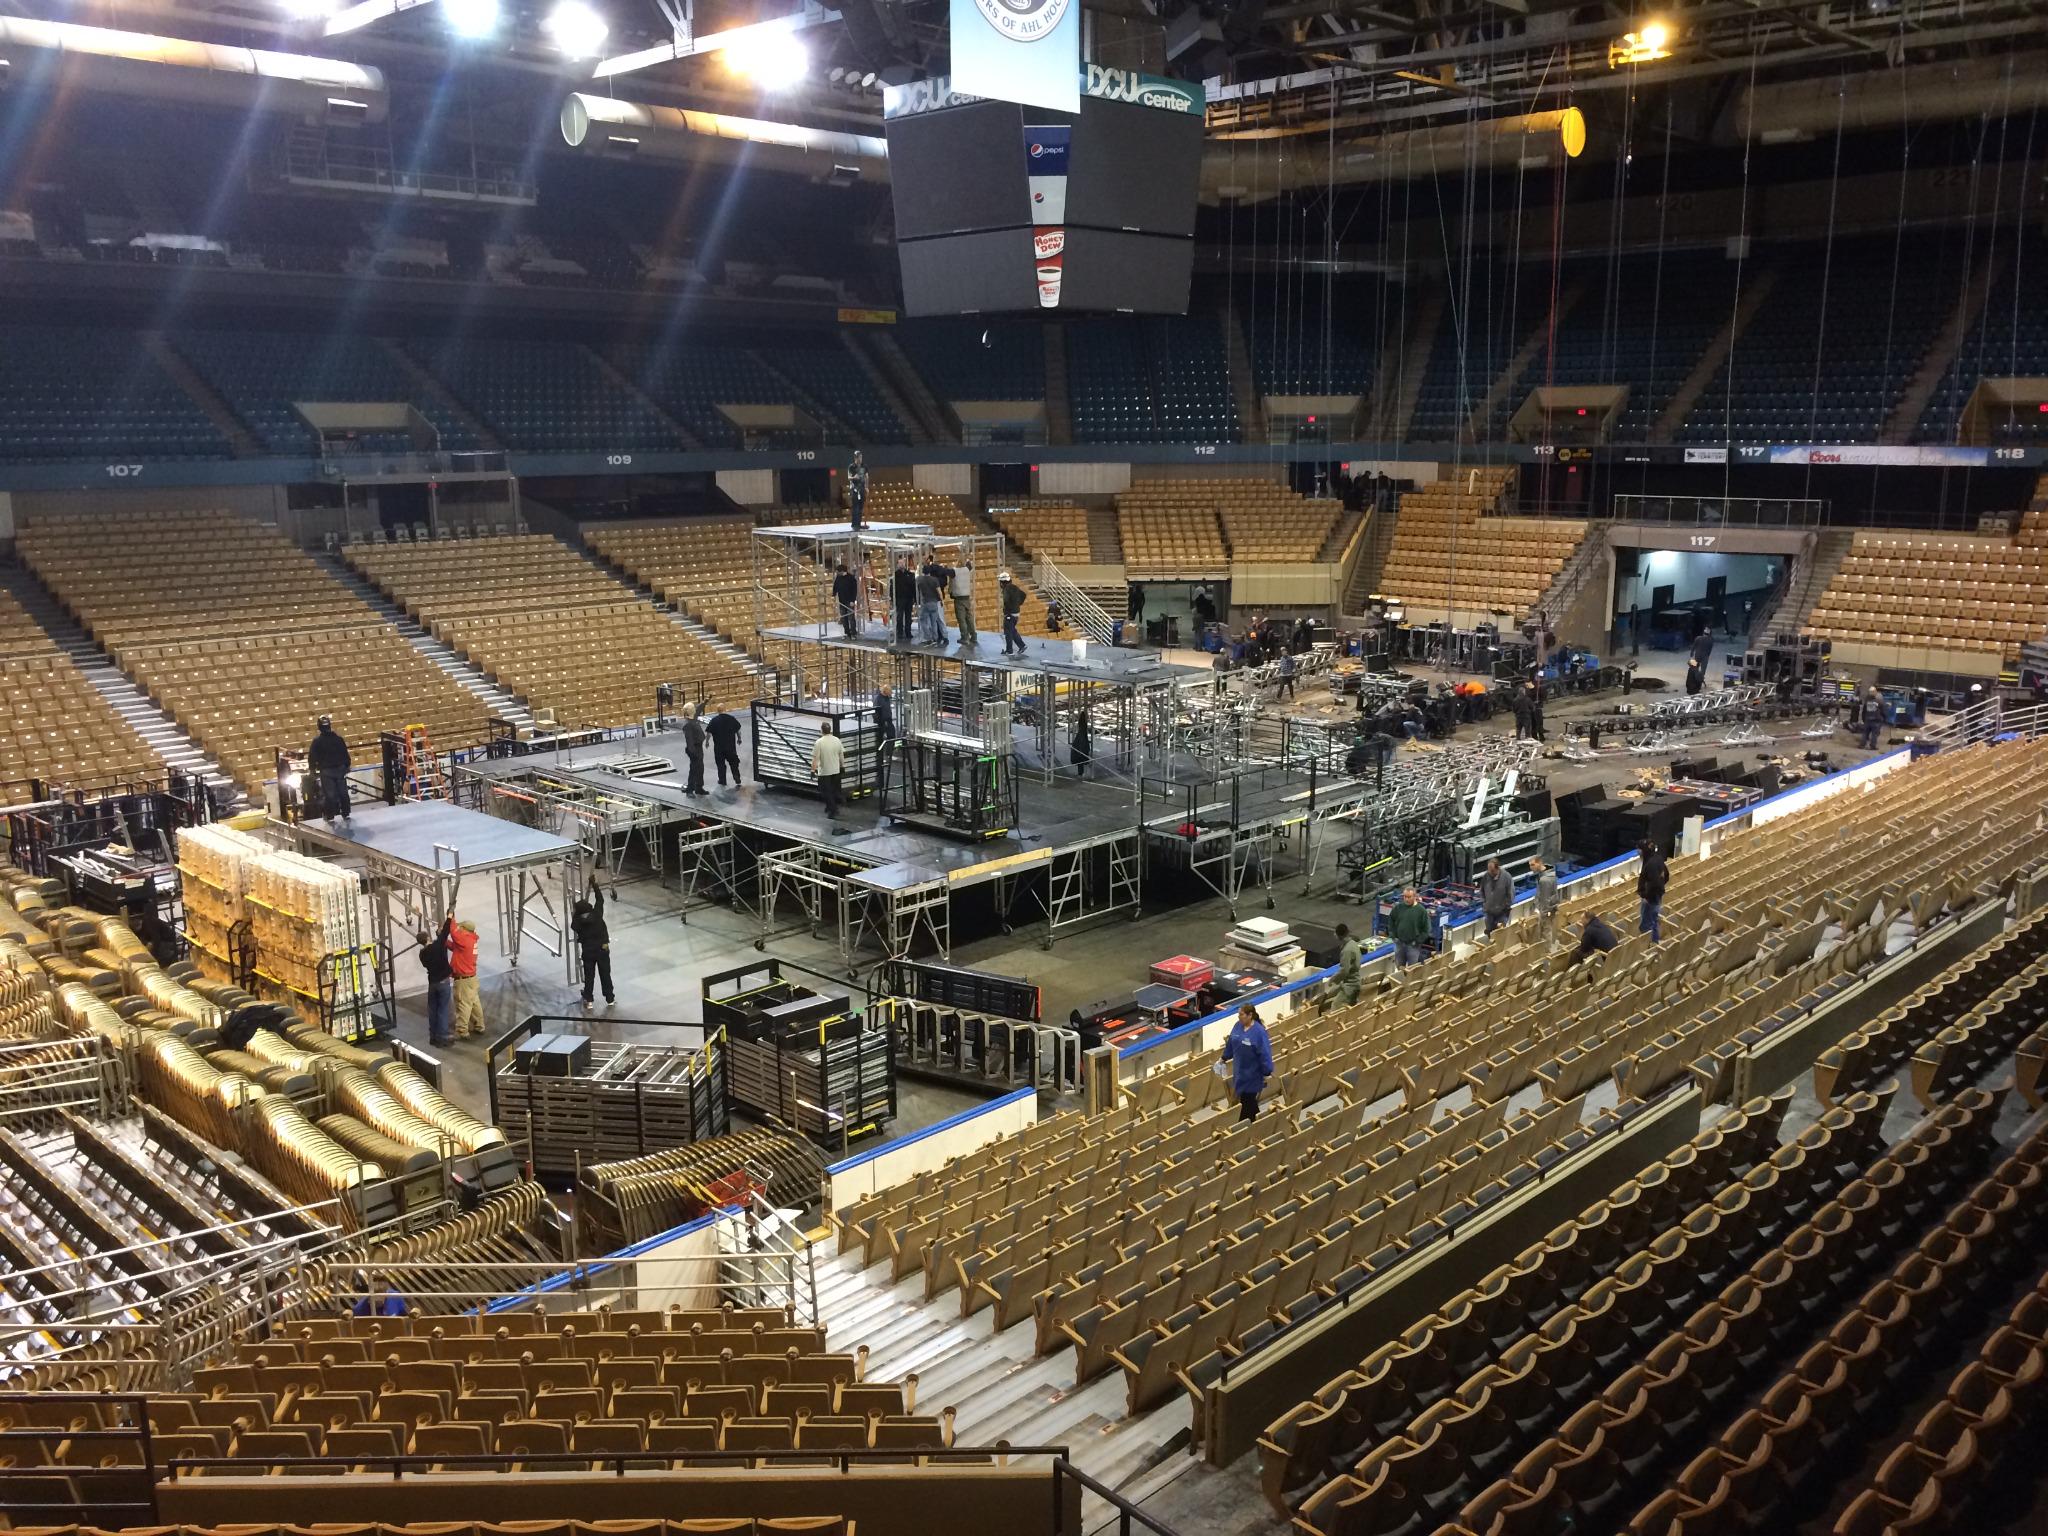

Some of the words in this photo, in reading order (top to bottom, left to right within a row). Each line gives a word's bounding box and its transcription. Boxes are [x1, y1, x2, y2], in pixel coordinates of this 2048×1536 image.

[1002, 16, 1016, 30] OF
[1021, 19, 1042, 33] AHL
[1087, 63, 1138, 103] DCU
[1143, 92, 1192, 112] center
[1044, 146, 1065, 154] pepsi
[1194, 446, 1216, 455] 112
[1533, 445, 1554, 455] 113
[1740, 447, 1765, 457] 117
[1995, 448, 2025, 459] 118
[606, 455, 632, 465] 109
[797, 451, 815, 461] 110
[1809, 450, 1840, 463] Coors
[106, 465, 143, 477] 107
[1690, 535, 1716, 546] 117
